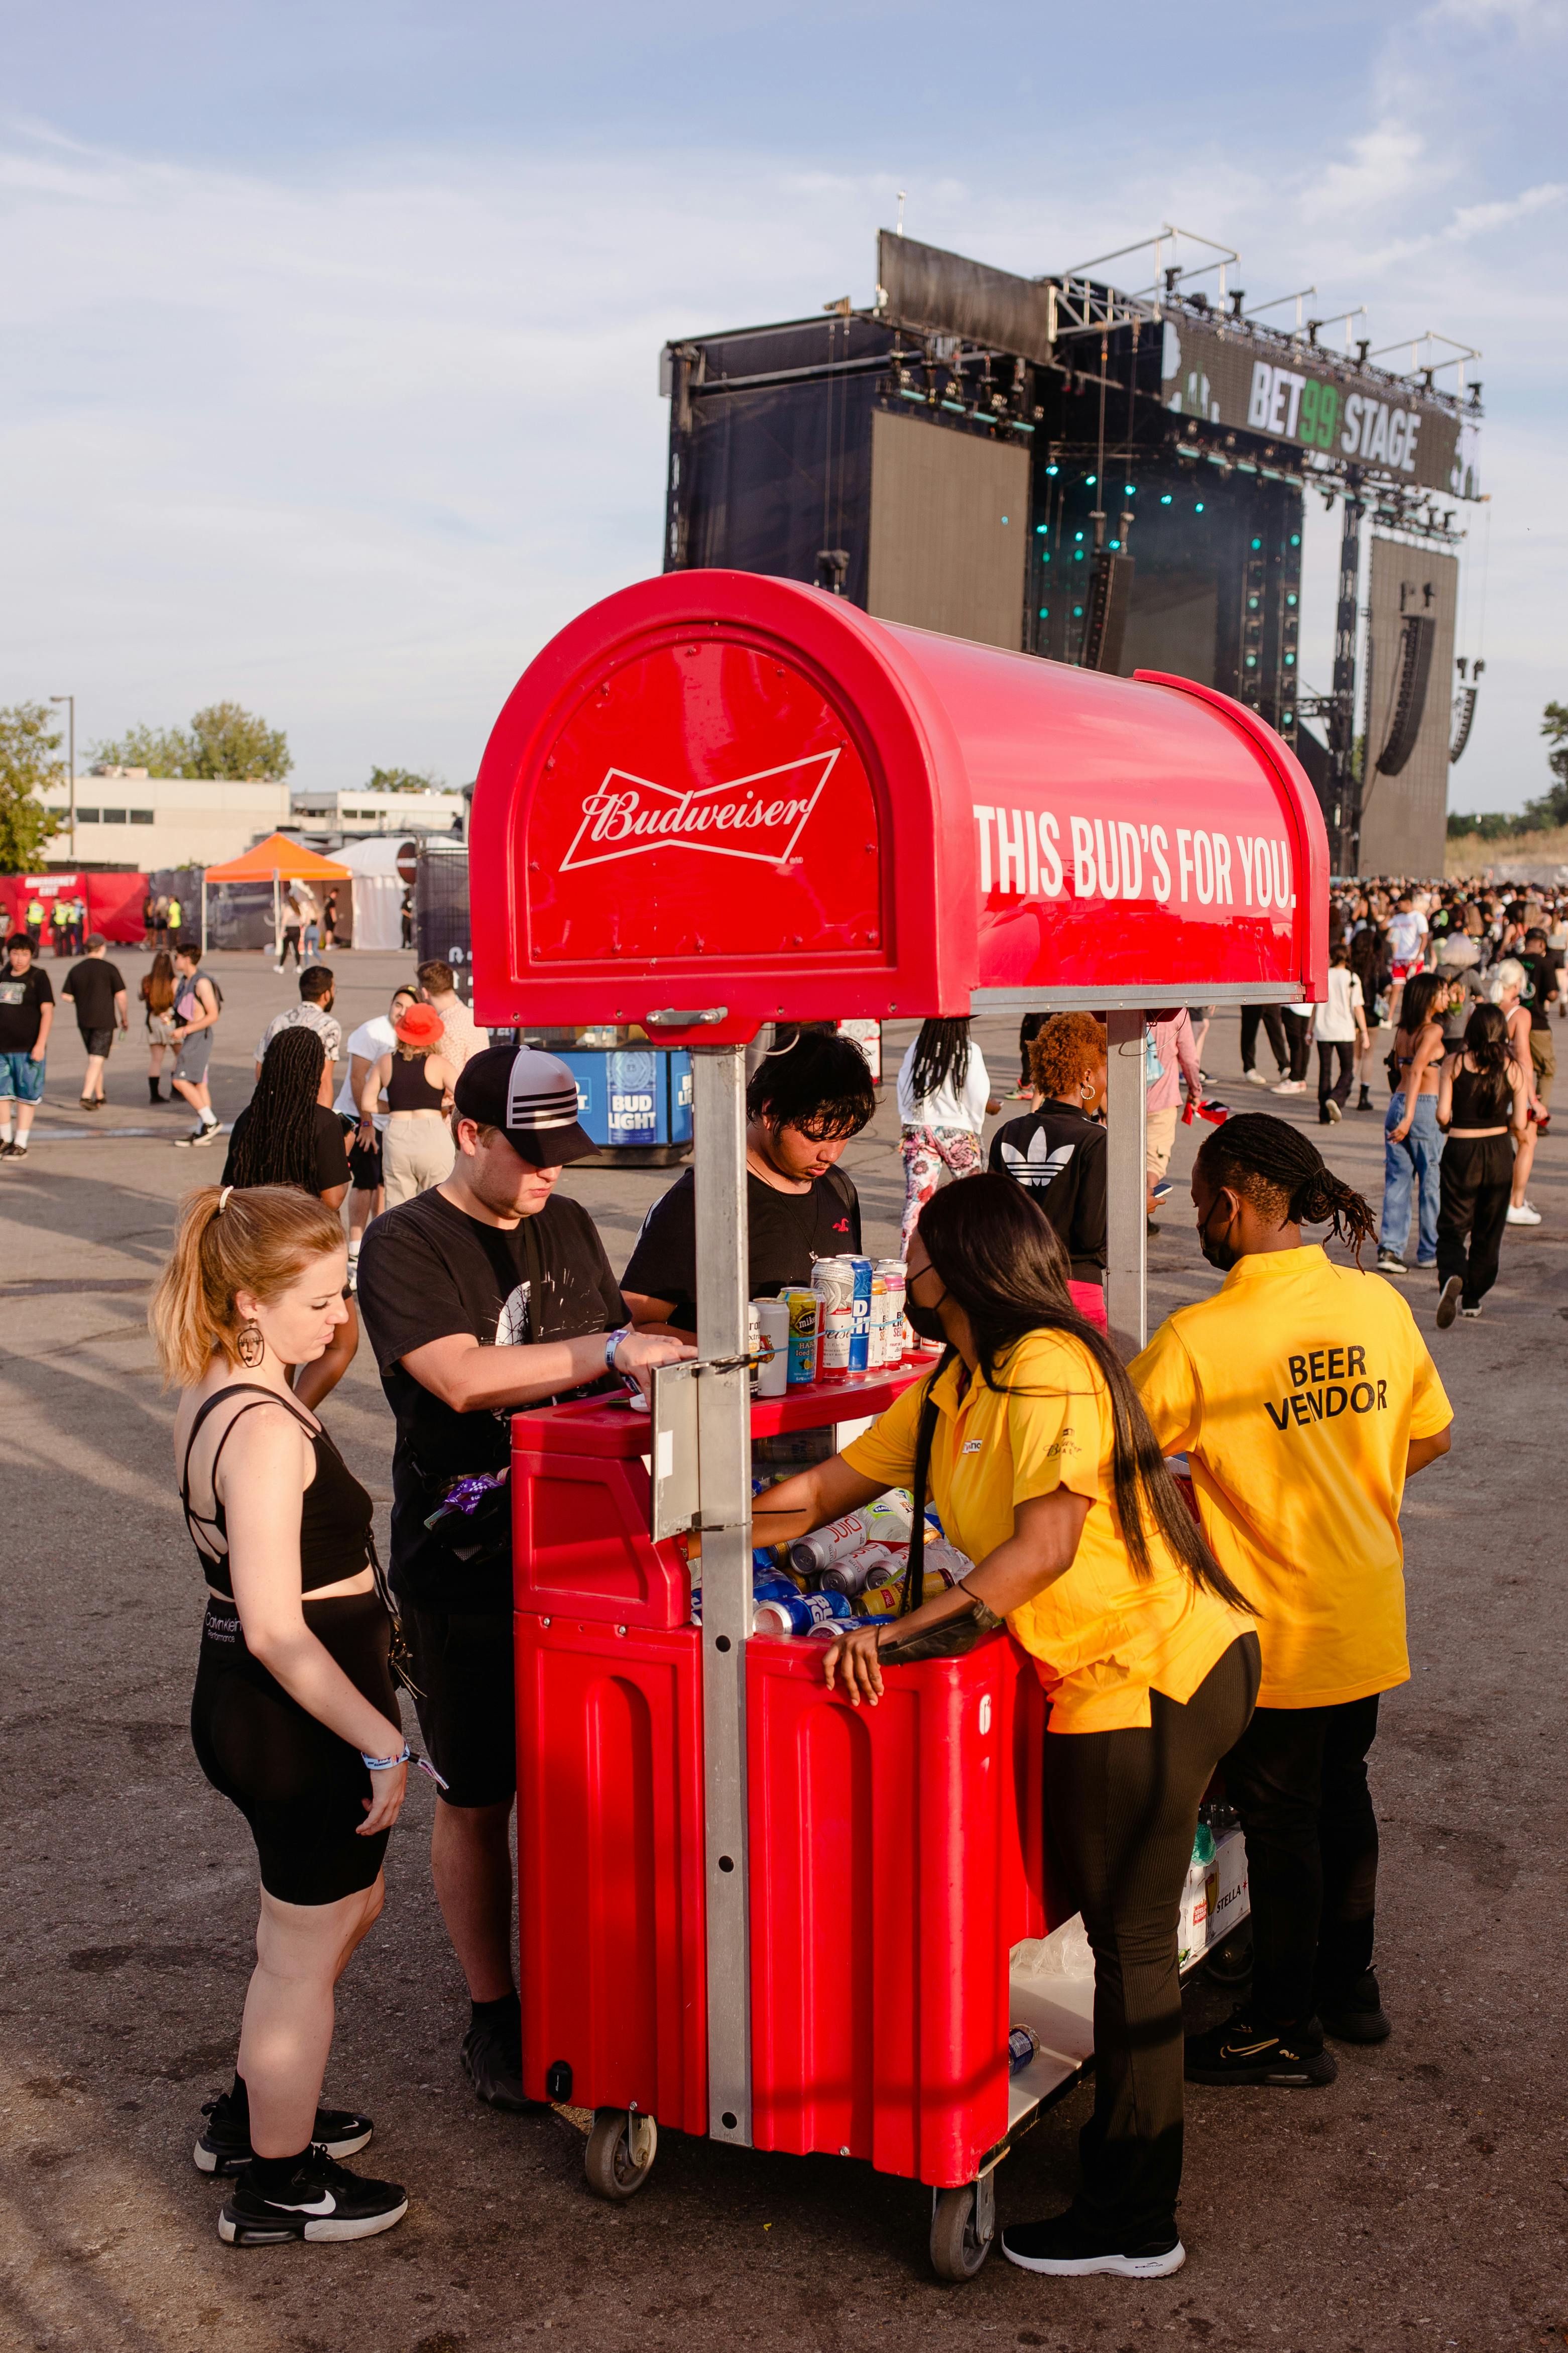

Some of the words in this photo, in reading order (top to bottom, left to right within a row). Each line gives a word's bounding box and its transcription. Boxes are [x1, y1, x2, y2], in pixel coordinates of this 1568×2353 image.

[1247, 360, 1339, 449] BET99
[1341, 393, 1422, 473] STAGE
[582, 790, 810, 842] Budweiser
[973, 804, 1063, 897] THIS
[1070, 816, 1171, 903] BUD'S
[1176, 828, 1234, 905] FOR
[1236, 835, 1296, 909] YOU.
[608, 1111, 656, 1130] LIGHT
[612, 1094, 652, 1112] BUD
[1288, 1345, 1367, 1388] BEER
[1263, 1379, 1387, 1431] VENDOR
[1217, 1884, 1241, 1914] STELLA
